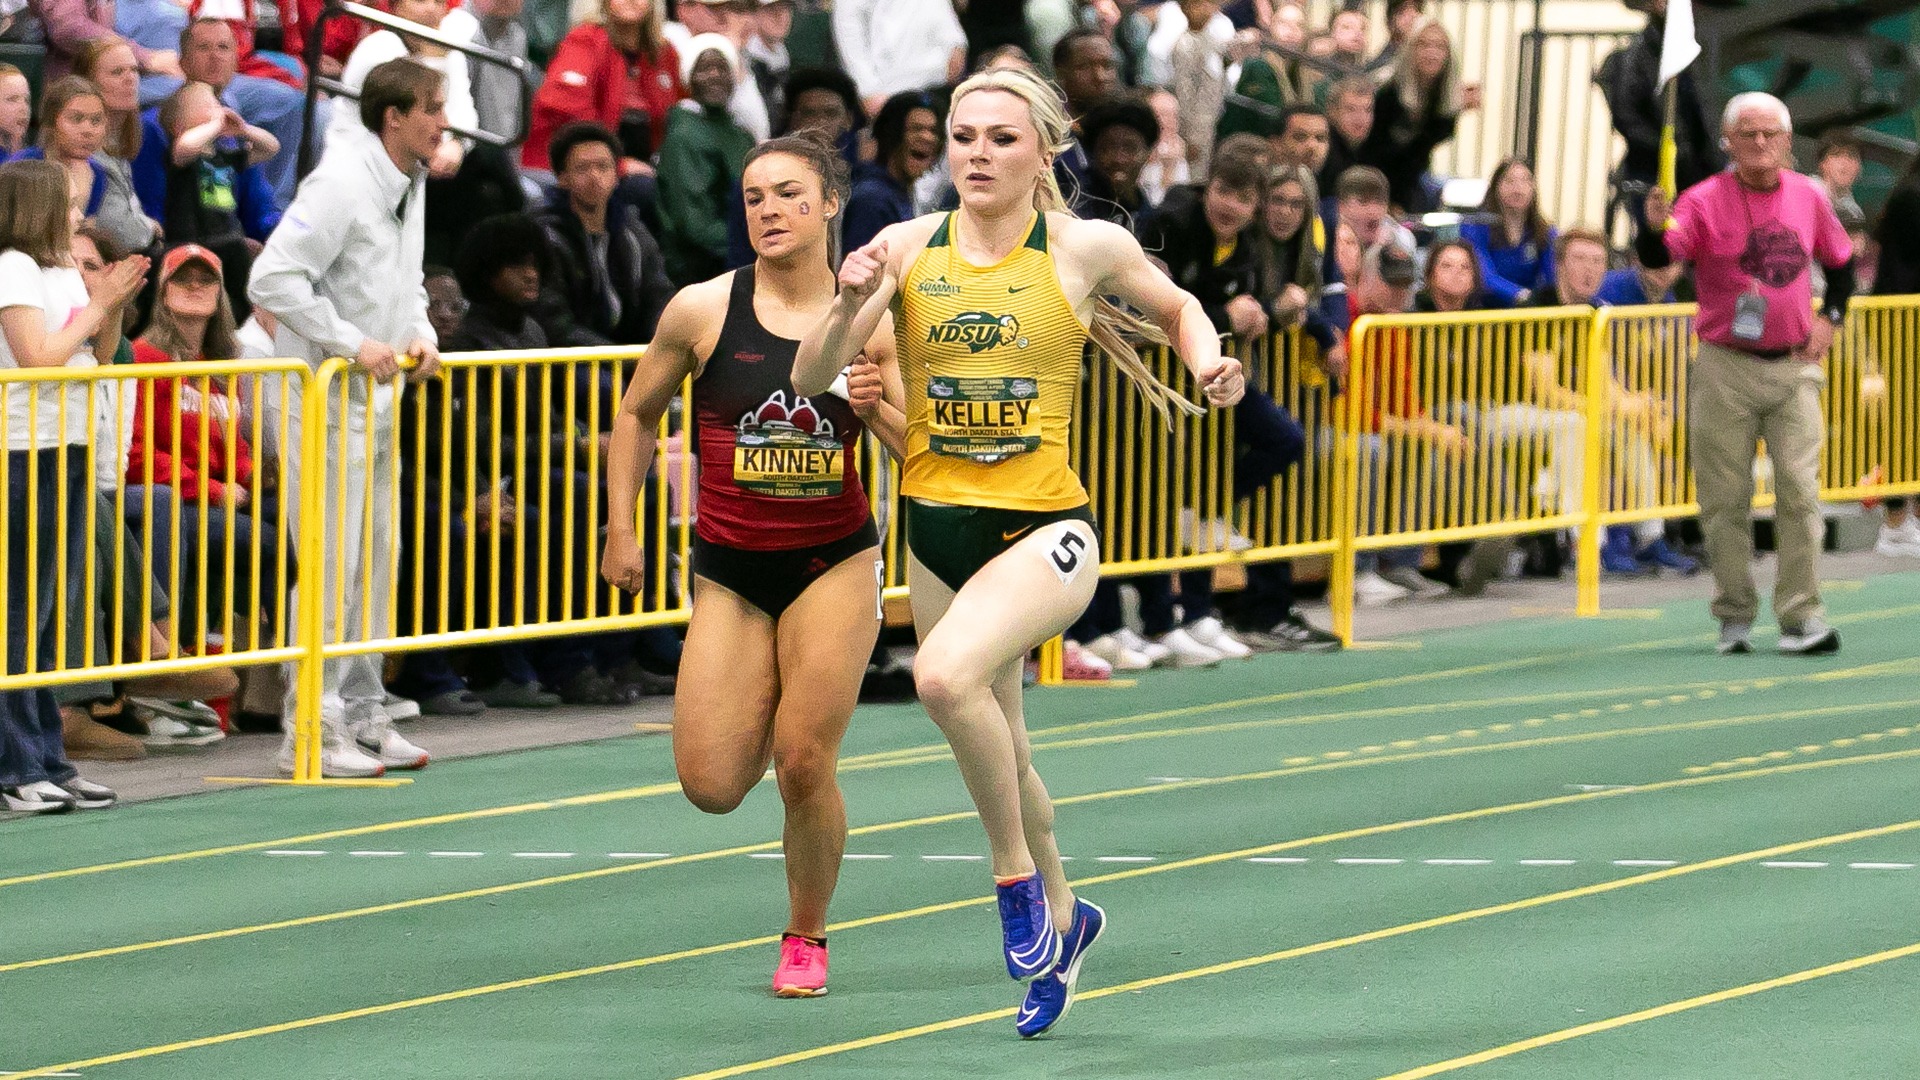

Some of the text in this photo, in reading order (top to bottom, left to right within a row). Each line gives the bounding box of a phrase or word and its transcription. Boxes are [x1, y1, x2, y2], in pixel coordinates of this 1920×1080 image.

[917, 282, 961, 293] SUMMIT
[926, 324, 997, 343] NDSU
[935, 400, 1031, 427] KELLEY
[944, 428, 1022, 437] NORTH DAKOTA STATE
[942, 444, 1026, 454] NORTH DAKOTA STATE
[743, 448, 836, 474] KINNEY
[775, 487, 805, 496] DAKOTA
[805, 487, 829, 496] STATE
[1051, 530, 1086, 573] 5
